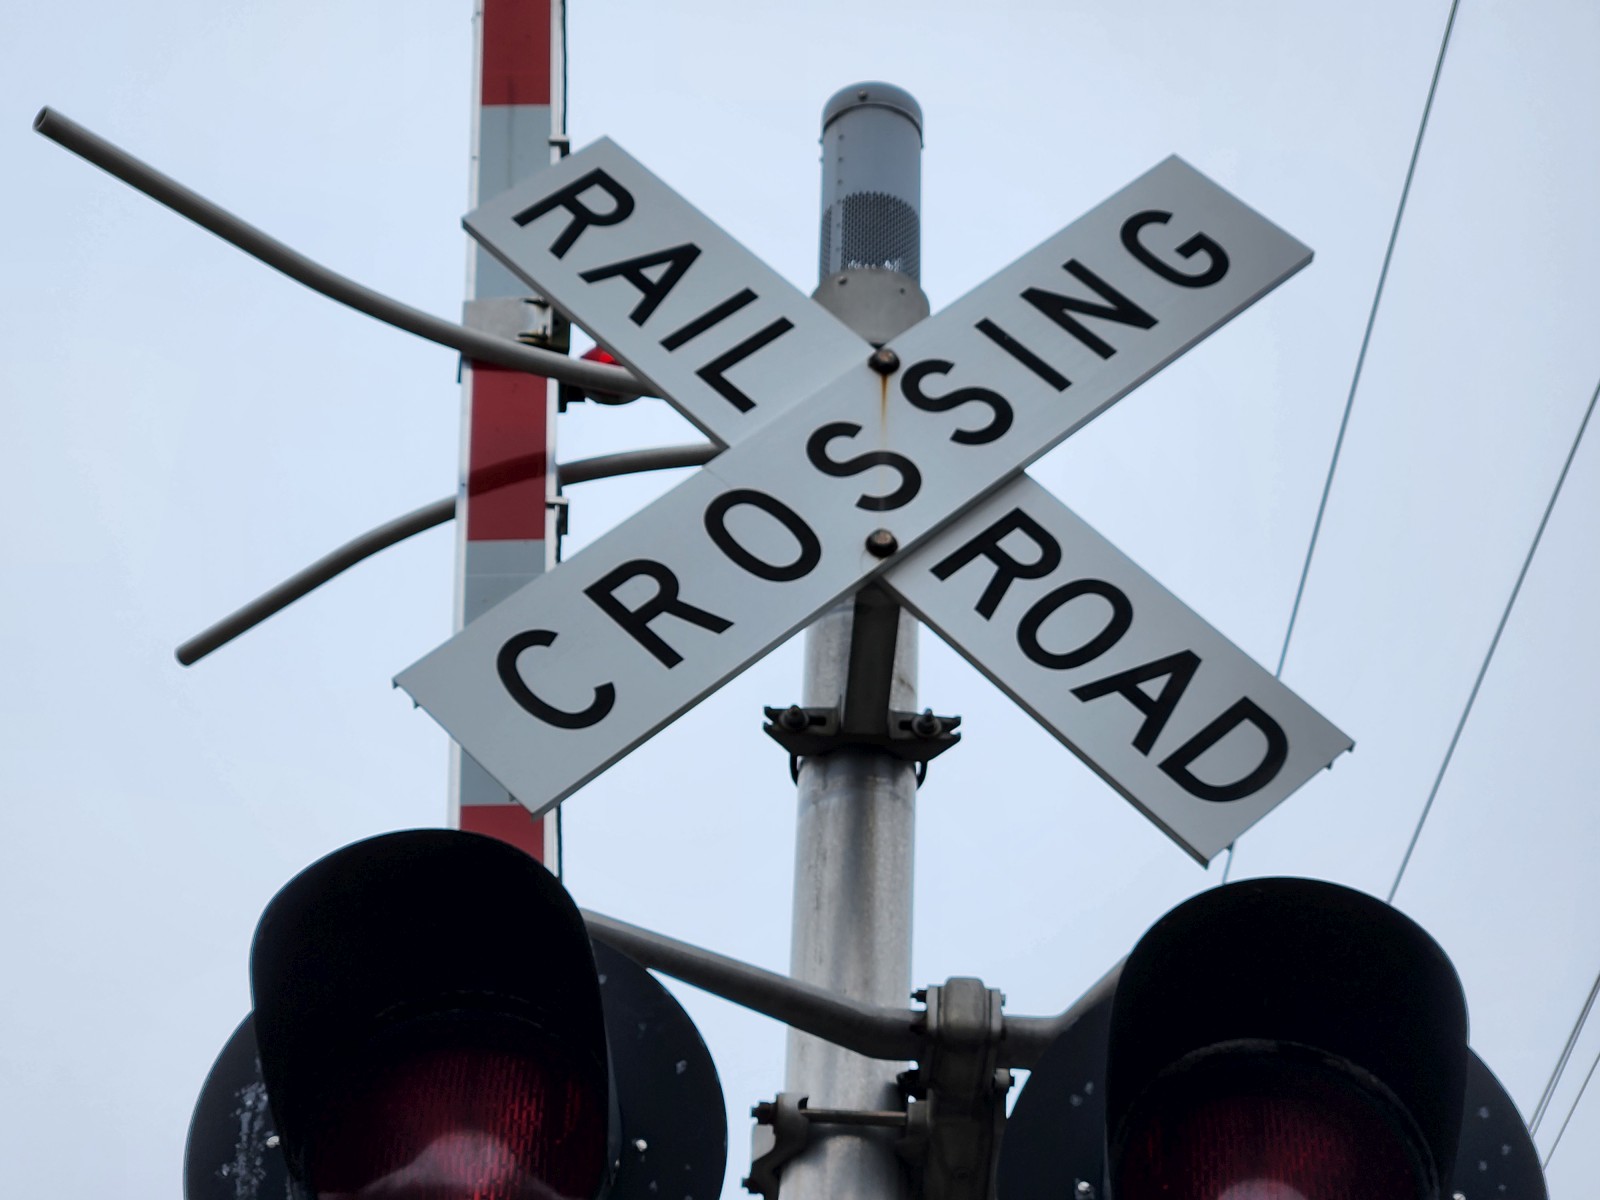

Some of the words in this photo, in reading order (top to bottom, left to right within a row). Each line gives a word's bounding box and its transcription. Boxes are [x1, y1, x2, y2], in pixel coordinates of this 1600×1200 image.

[496, 209, 1231, 730] CROSSING
[511, 167, 795, 414] RAIL
[929, 507, 1290, 803] ROAD
